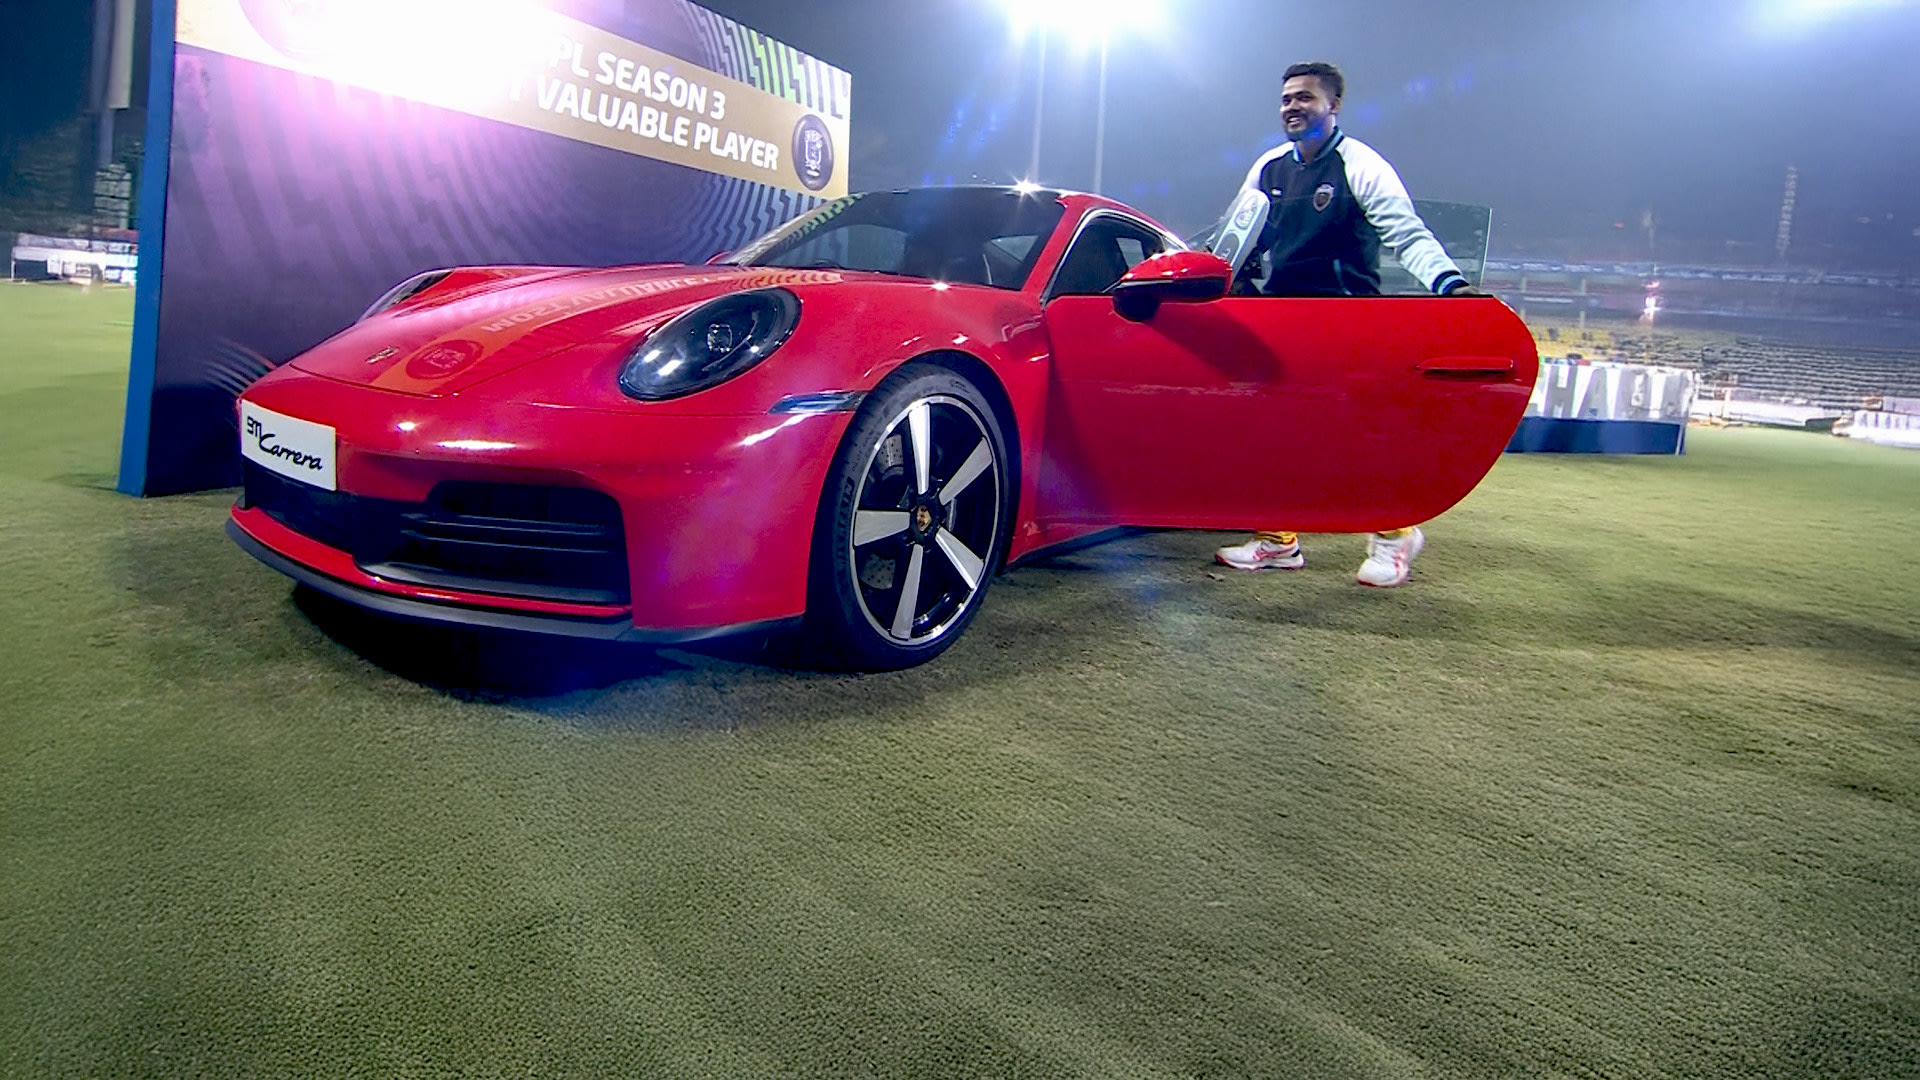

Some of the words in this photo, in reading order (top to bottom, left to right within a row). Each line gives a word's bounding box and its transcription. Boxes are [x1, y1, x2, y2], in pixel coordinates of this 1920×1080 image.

[594, 51, 708, 115] SEASON
[709, 89, 727, 121] 3
[537, 75, 691, 147] VALUABLE
[692, 120, 780, 171] PLAYER
[258, 433, 323, 470] Carrera
